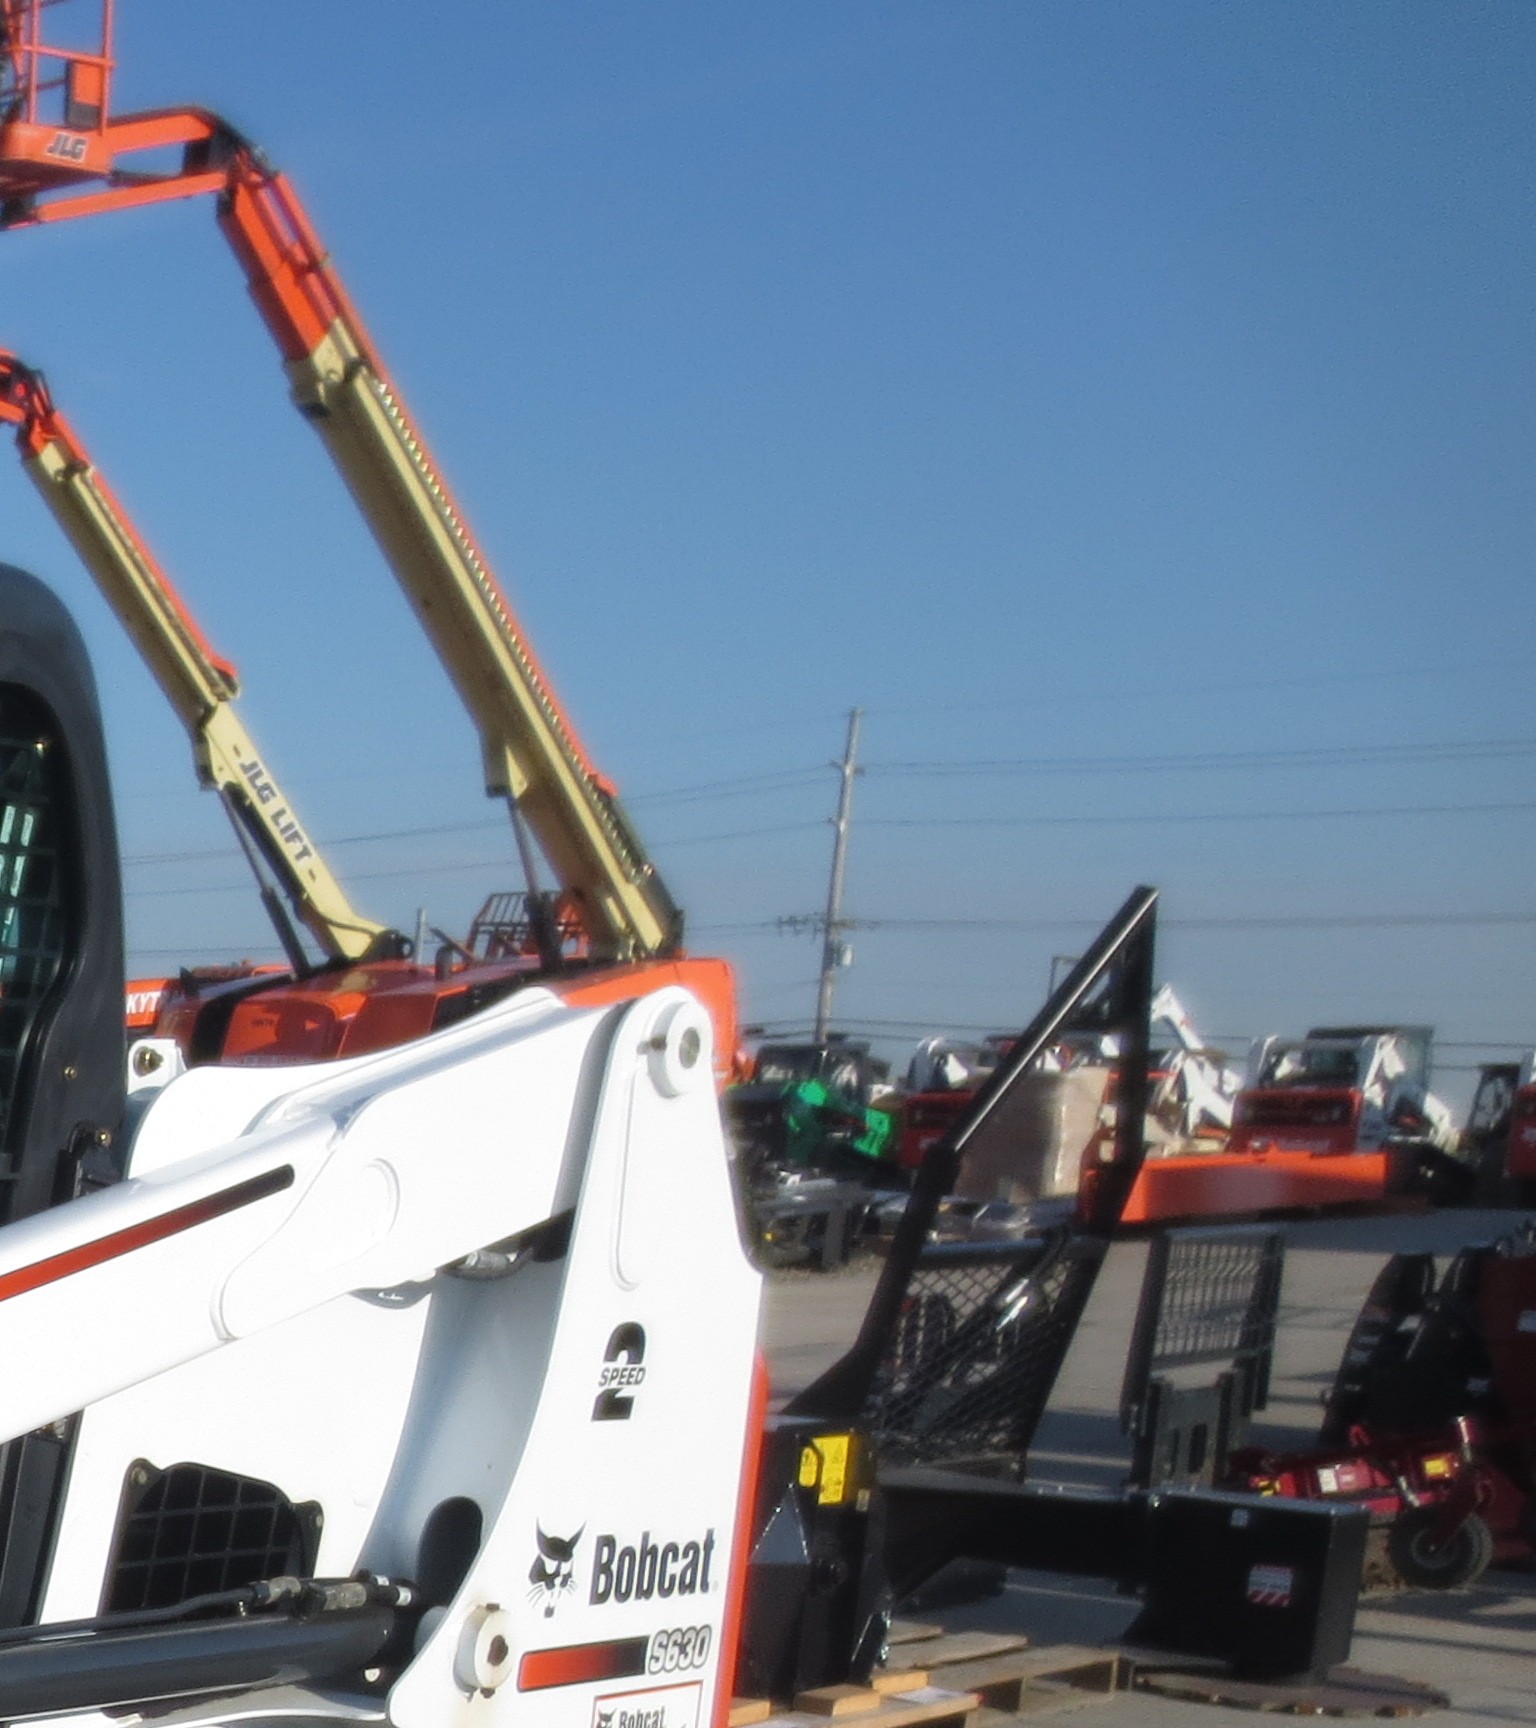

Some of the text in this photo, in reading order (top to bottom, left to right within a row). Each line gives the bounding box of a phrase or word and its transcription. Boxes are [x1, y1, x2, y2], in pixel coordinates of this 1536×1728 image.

[45, 132, 88, 163] JLG
[239, 760, 313, 862] JLG LIFT
[598, 1367, 646, 1387] SPEED
[589, 1528, 715, 1606] Bobcat
[648, 1624, 712, 1675] S630
